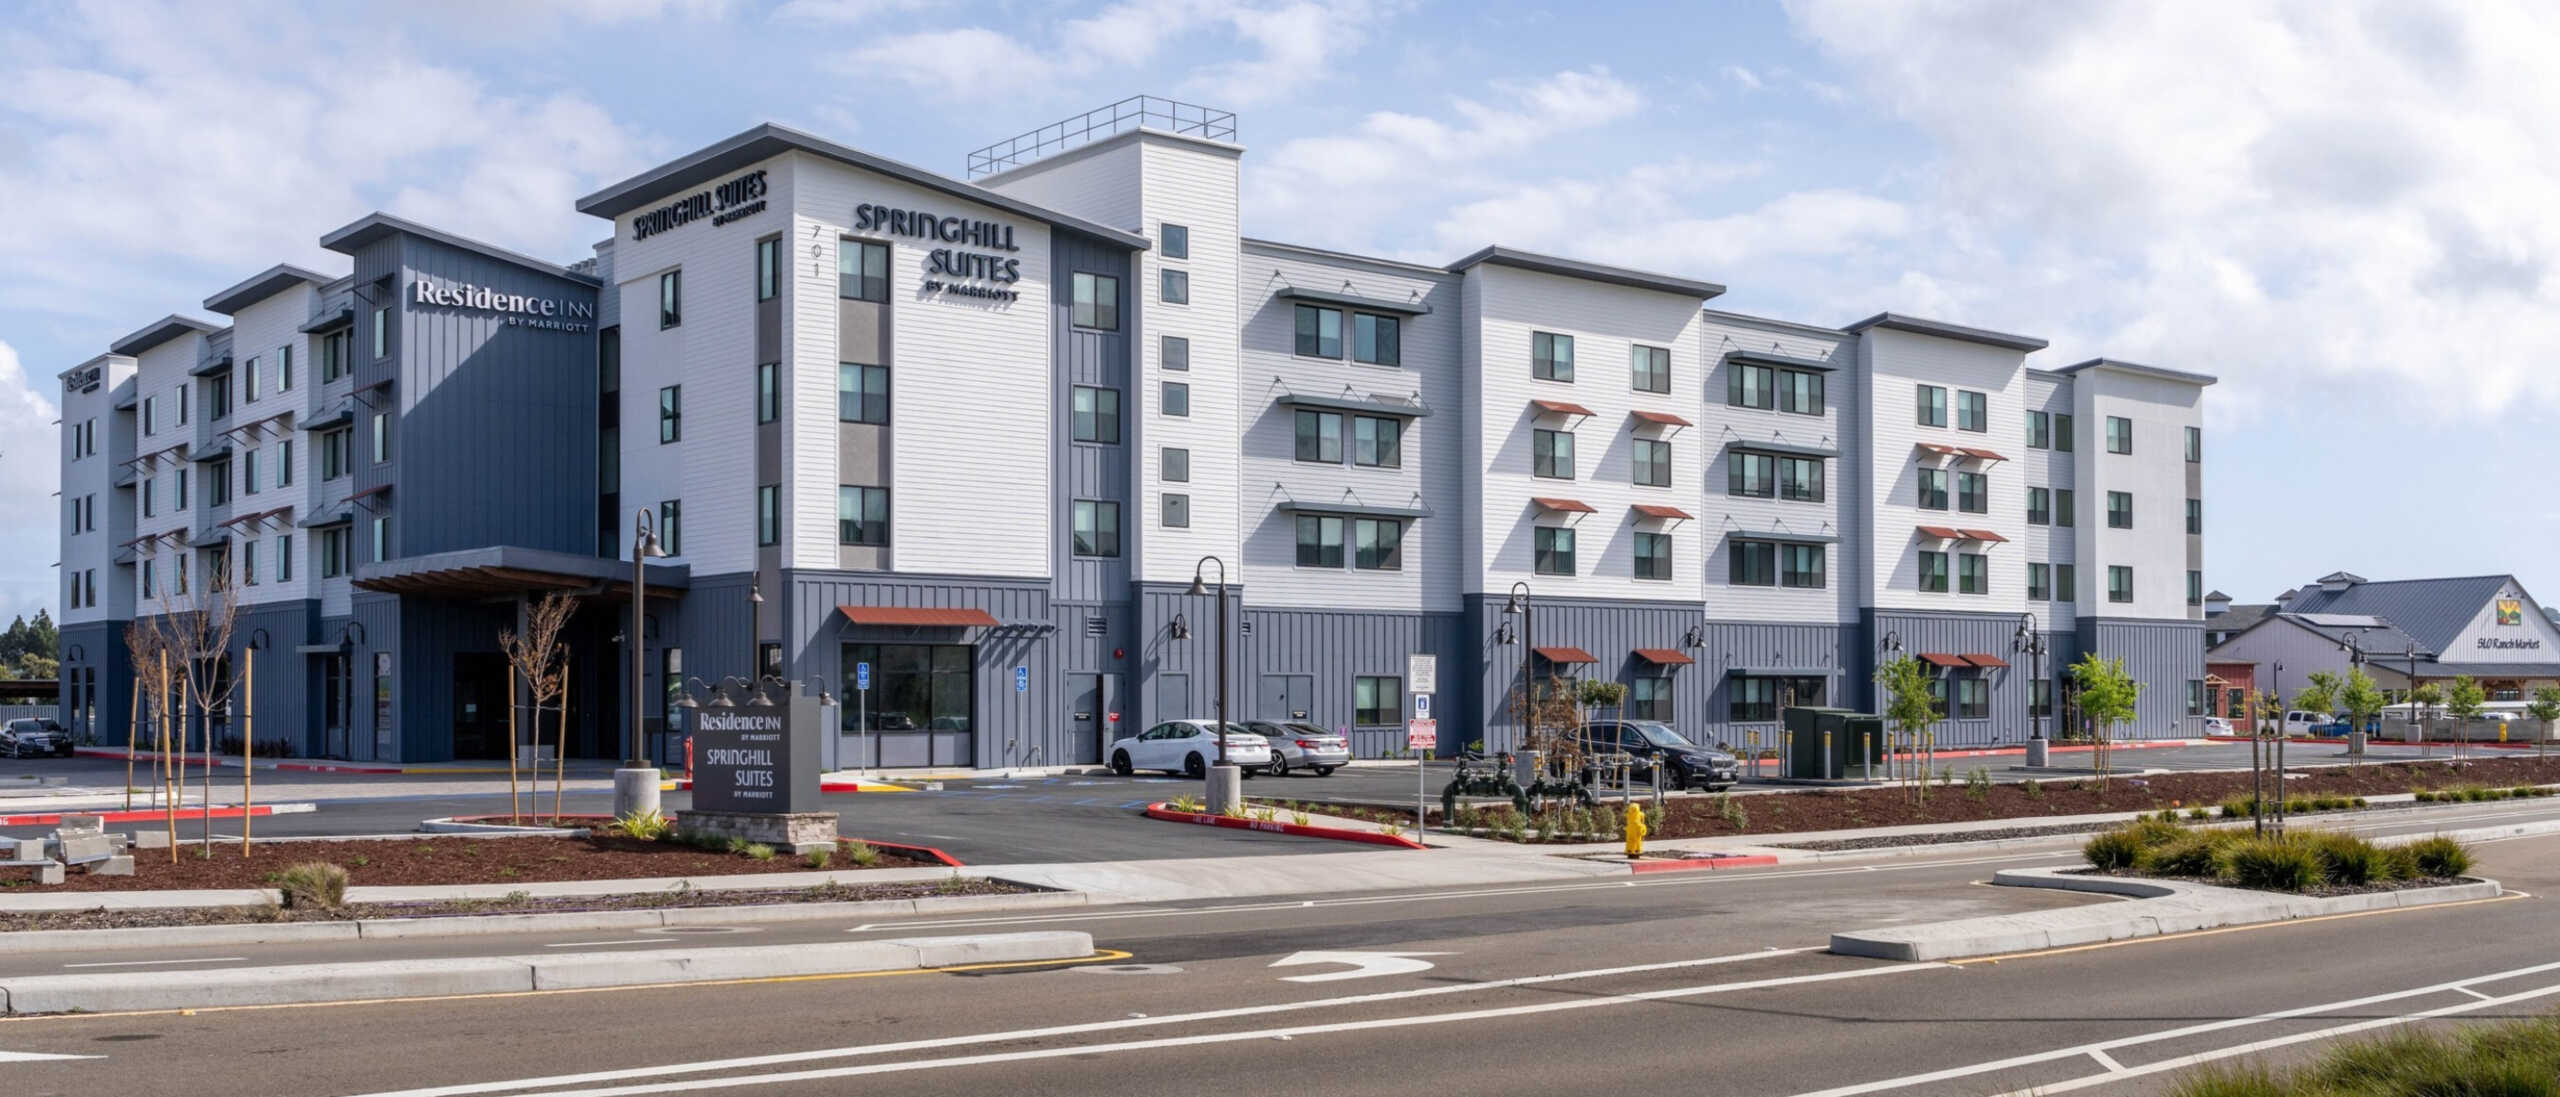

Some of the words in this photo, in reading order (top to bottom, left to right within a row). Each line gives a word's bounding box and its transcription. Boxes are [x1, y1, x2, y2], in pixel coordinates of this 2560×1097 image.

[632, 191, 714, 241] SPRINGHILL
[715, 170, 767, 212] SUITES
[856, 203, 1020, 252] SPRINGHILL
[811, 225, 822, 277] 701
[929, 248, 1020, 284] SUITES
[416, 280, 555, 317] Residence
[559, 299, 593, 320] INN
[925, 280, 944, 292] BY
[948, 284, 1020, 302] MARRIOTT
[509, 317, 524, 326] BY
[528, 319, 589, 333] MARRIOTT
[2493, 638, 2515, 649] Ranch
[2515, 638, 2540, 649] Market
[700, 712, 763, 731] Residence
[765, 716, 781, 731] INN
[707, 749, 774, 766] SPRINGHILL
[736, 770, 774, 787] SUITES
[743, 791, 773, 799] MARRIOTT
